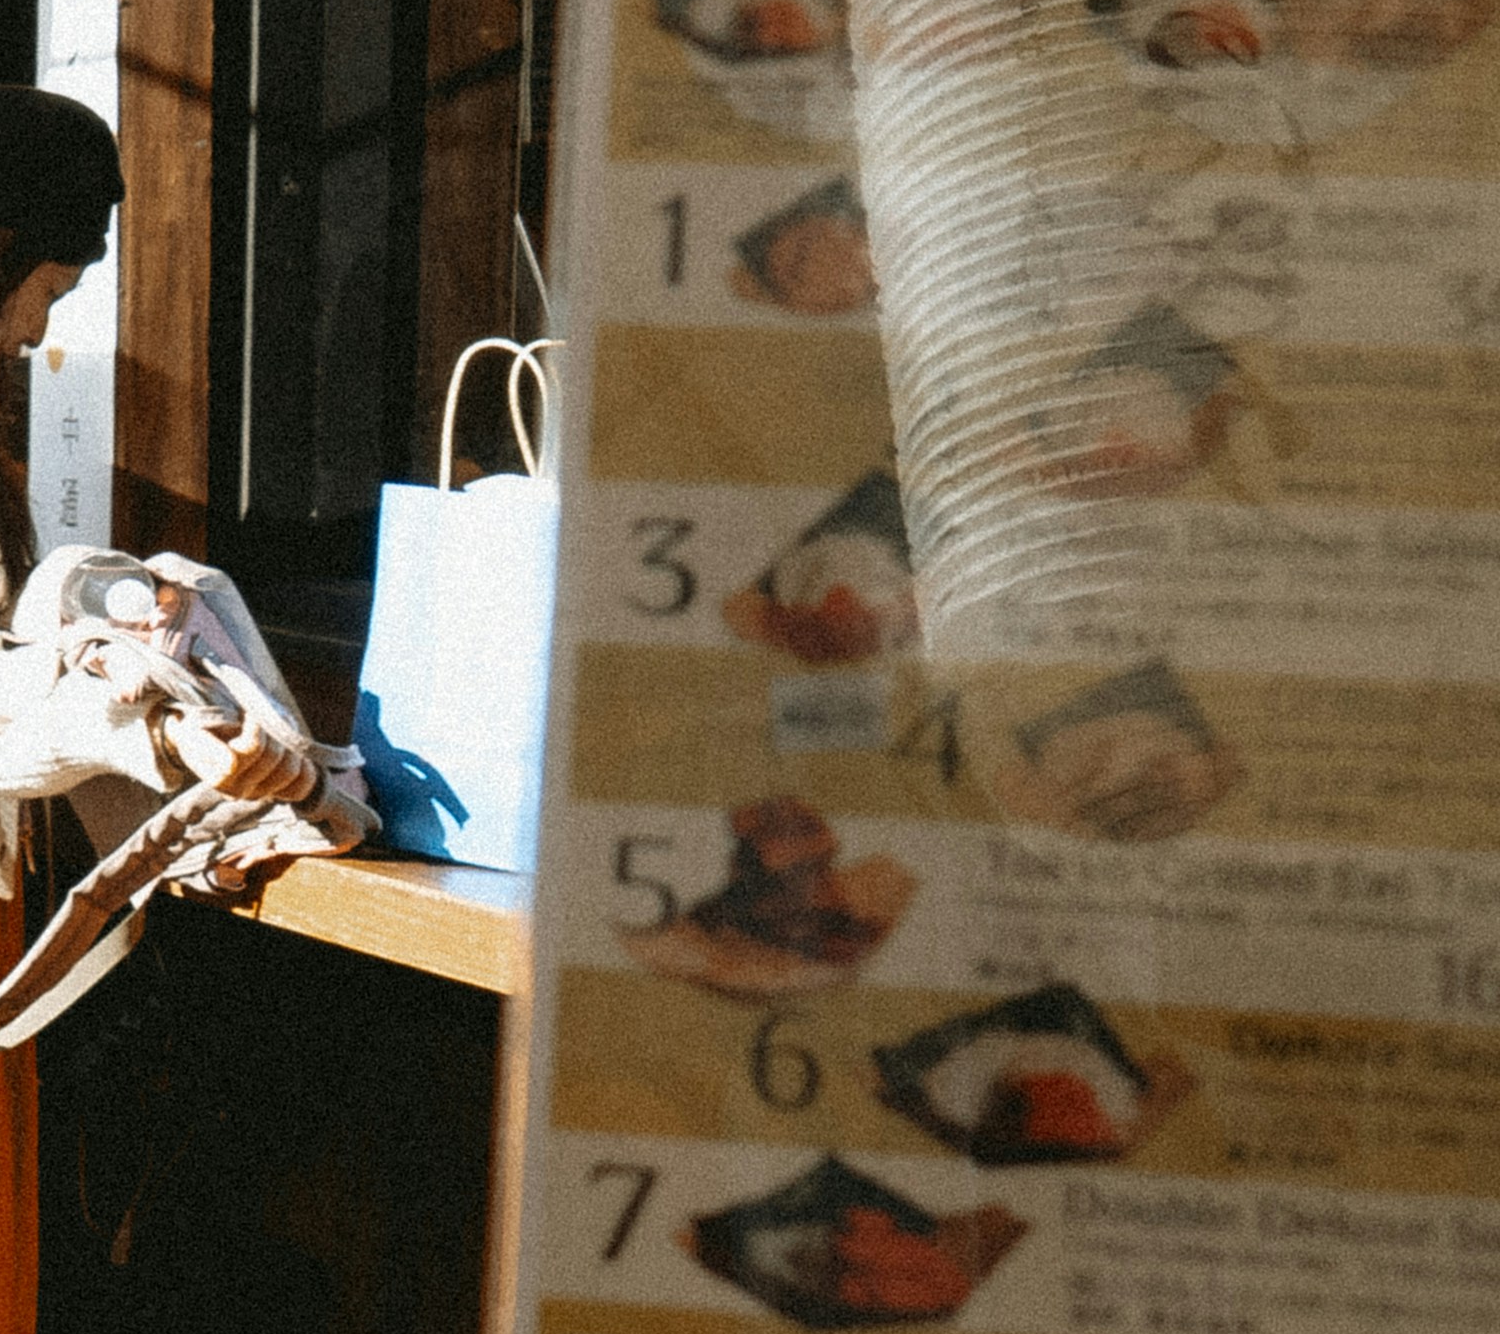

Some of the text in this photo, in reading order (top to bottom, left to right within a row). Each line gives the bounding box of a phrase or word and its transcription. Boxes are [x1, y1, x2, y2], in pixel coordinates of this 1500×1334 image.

[658, 193, 687, 287] 1
[628, 516, 699, 618] 3
[610, 835, 681, 935] 5
[747, 1005, 823, 1113] 6
[584, 1161, 660, 1263] 7
